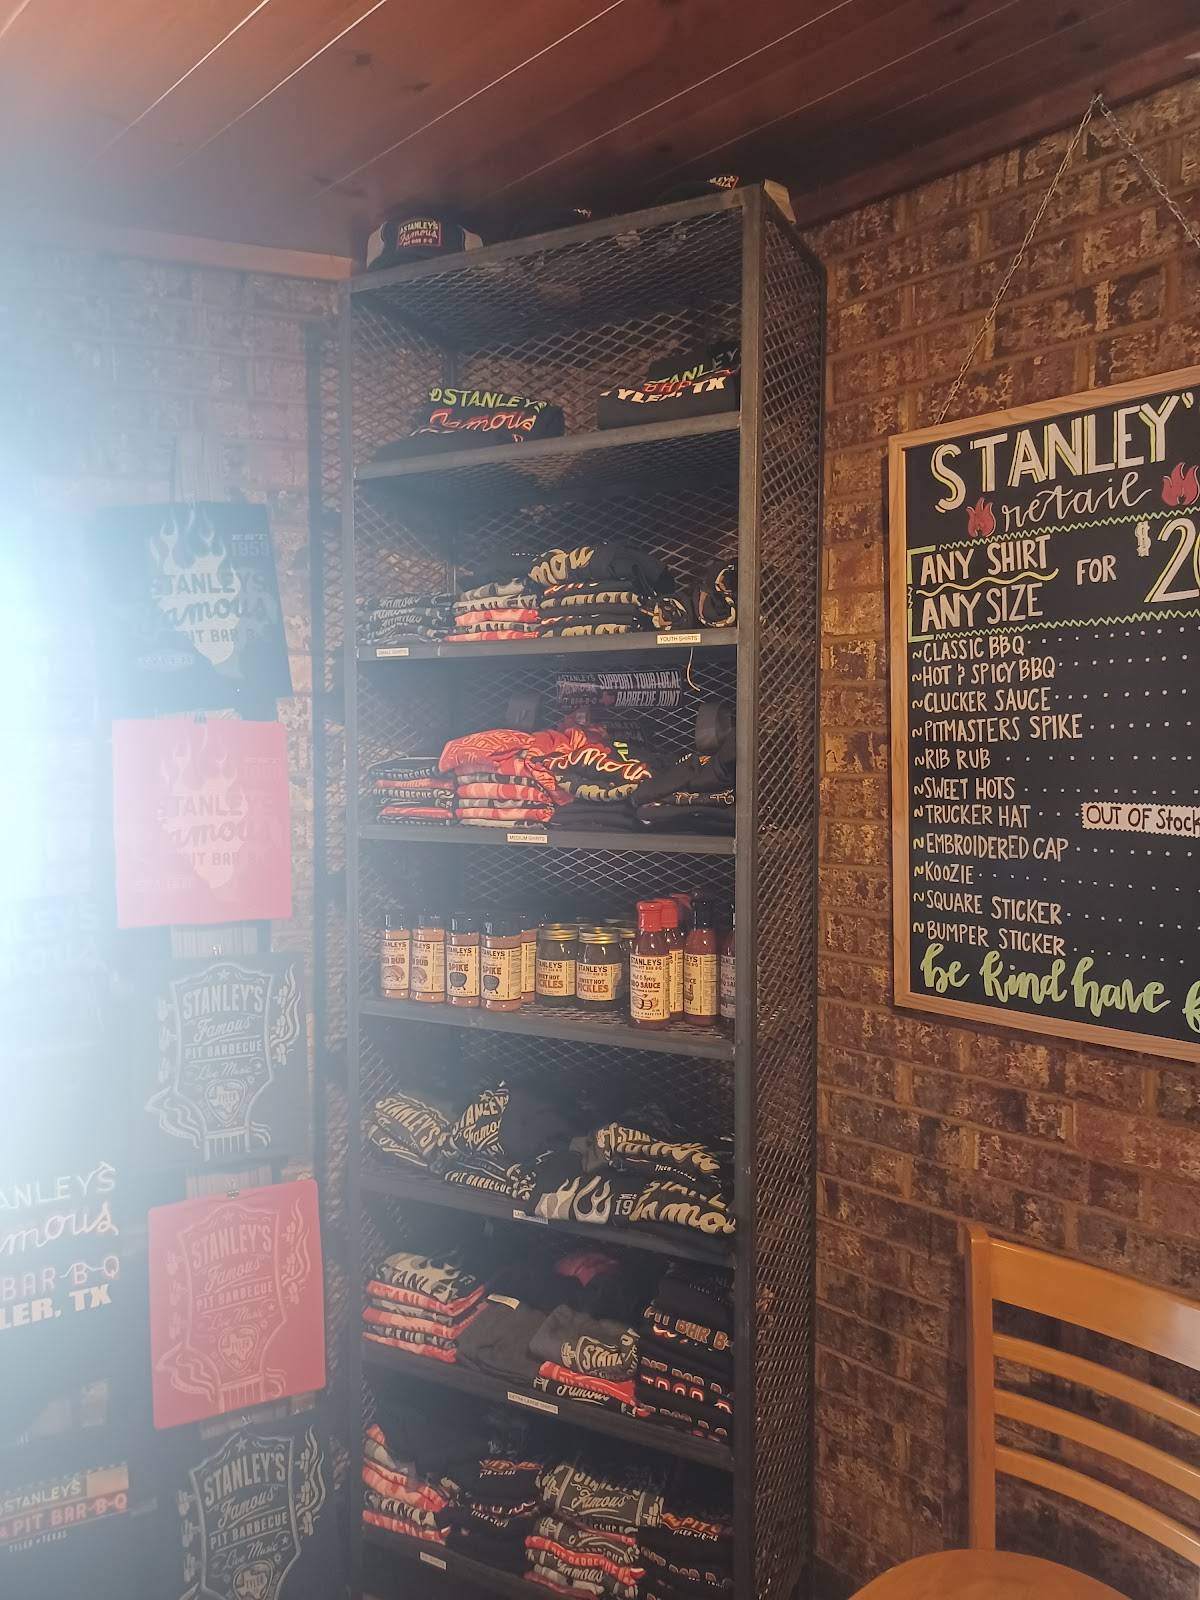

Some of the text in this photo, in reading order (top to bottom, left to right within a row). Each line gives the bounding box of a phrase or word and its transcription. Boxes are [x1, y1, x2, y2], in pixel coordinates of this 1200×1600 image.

[692, 377, 726, 394] TX
[1001, 471, 1152, 532] retail
[920, 535, 1052, 586] ANY SHIRT
[1076, 554, 1117, 586] FOR
[921, 582, 1044, 633] ANY SIZE
[989, 635, 1025, 659] BBQ
[971, 661, 1016, 685] SPICY
[1019, 656, 1056, 681] BBQ
[994, 687, 1052, 712] SAUCE
[1029, 713, 1083, 740] SPIKE
[956, 748, 991, 769] RUB
[975, 776, 1016, 800] HOTS
[998, 804, 1032, 828] HAT
[1086, 804, 1122, 826] OUT
[1127, 807, 1152, 828] OF
[1032, 837, 1069, 862] CAP
[991, 896, 1063, 925] STICKER
[998, 928, 1067, 956] STICKER
[448, 963, 469, 972] SPIKE
[482, 965, 502, 975] SPIKE
[920, 943, 970, 993] be
[980, 950, 1067, 1005] kind
[1071, 956, 1171, 1017] have
[183, 983, 264, 1019] STANLEY'S
[207, 1039, 263, 1057] BARBECUE
[191, 1224, 272, 1269] STANLEY'S
[69, 1283, 112, 1312] TX
[218, 1280, 273, 1305] BARBECUE
[204, 1452, 287, 1505] STANLEY'S
[217, 1488, 277, 1529] Famous
[210, 1511, 289, 1550] PIT BARBECUE
